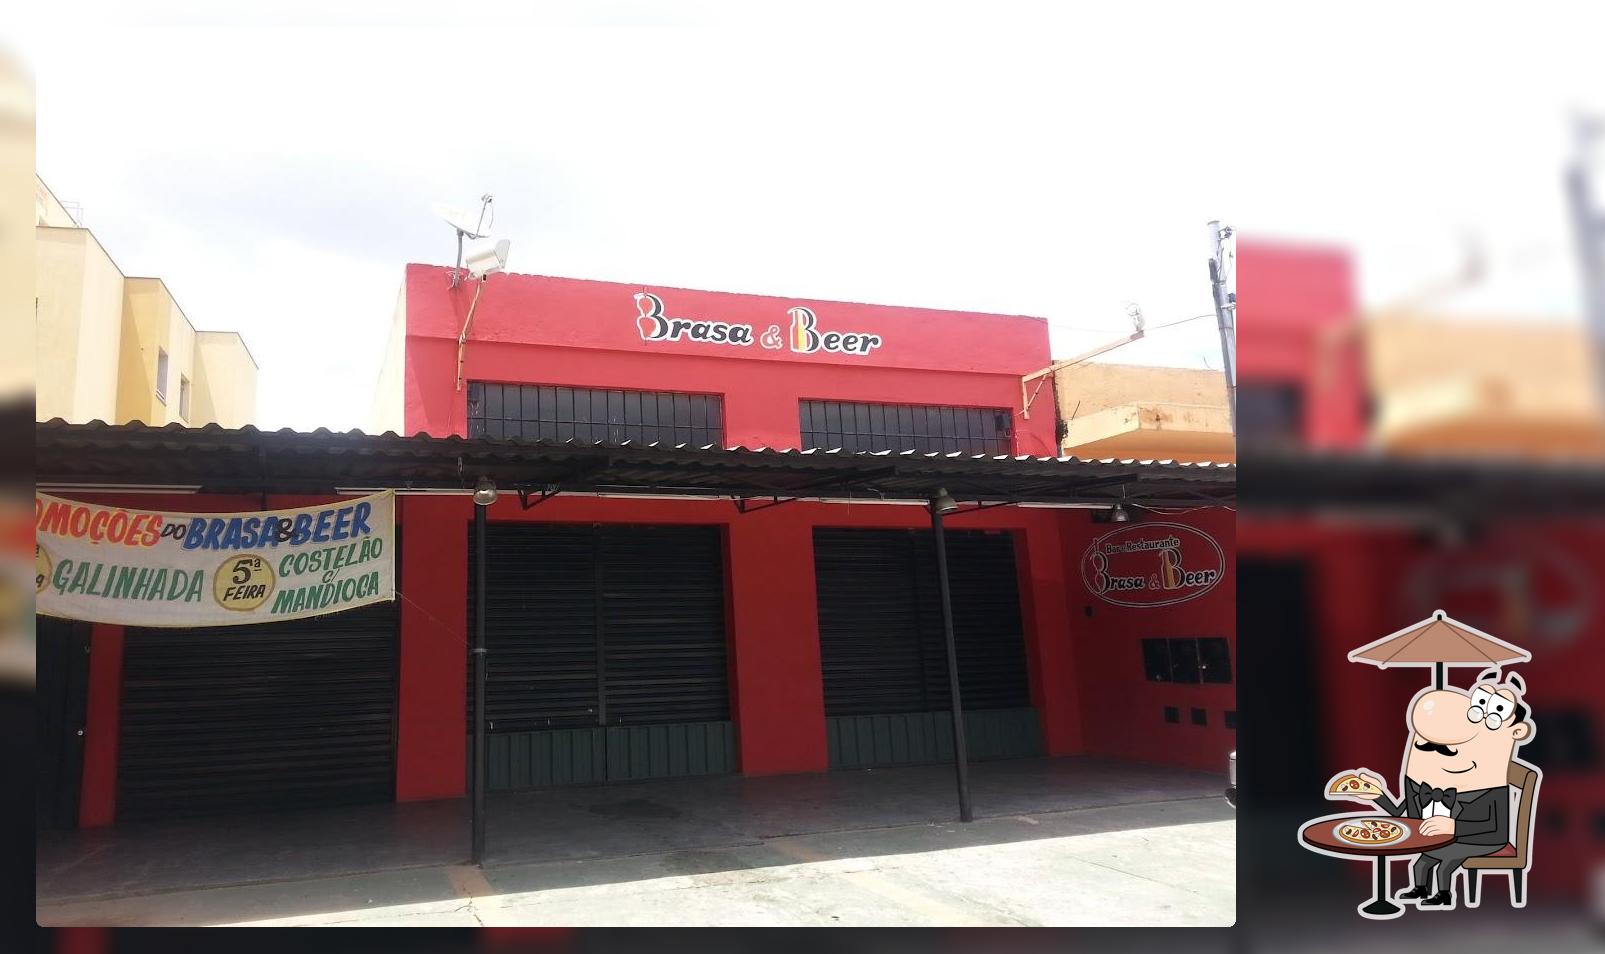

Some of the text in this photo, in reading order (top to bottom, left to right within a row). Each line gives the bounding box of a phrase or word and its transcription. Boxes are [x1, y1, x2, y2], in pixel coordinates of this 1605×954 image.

[634, 293, 882, 355] Brasa & Beer
[160, 524, 187, 540] DO
[183, 517, 279, 550] BRASA
[274, 518, 295, 542] &
[290, 502, 371, 545] BEER
[279, 536, 383, 578] COSTELÃO
[1091, 548, 1217, 595] Brasa & Beer
[53, 559, 204, 602] GALINHADA
[223, 584, 266, 601] FEIRA
[271, 571, 379, 614] MANDIOCA
